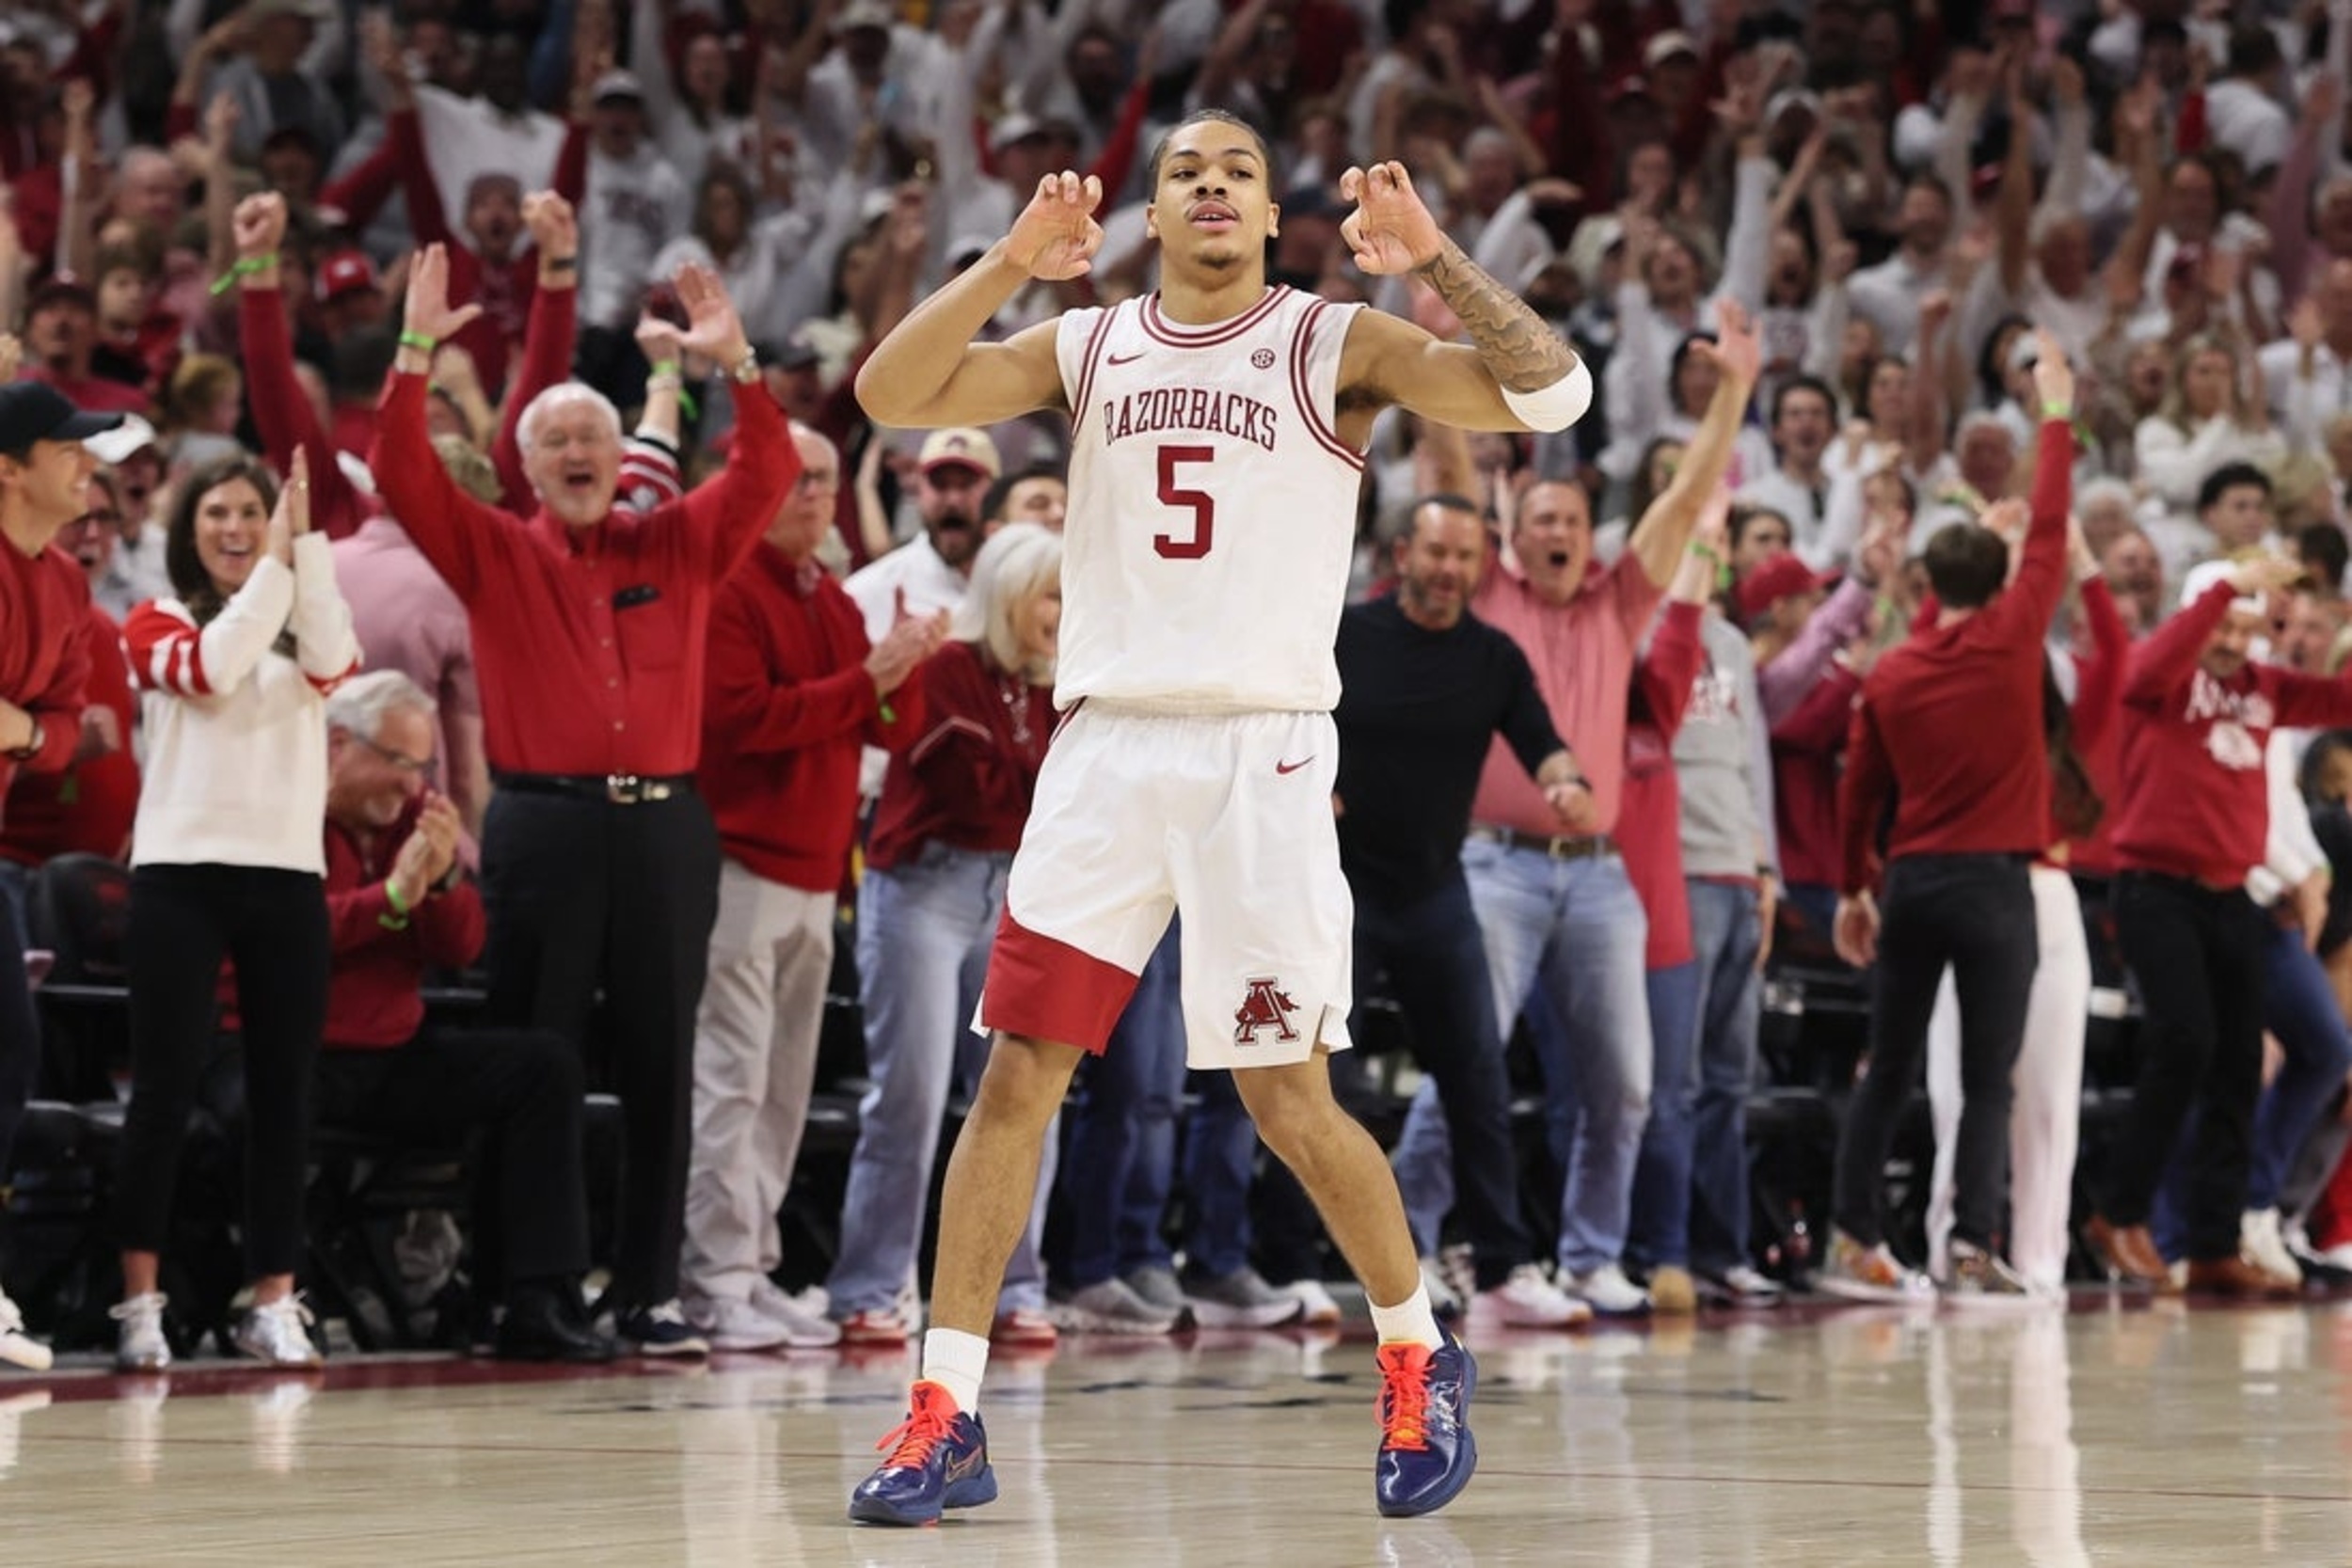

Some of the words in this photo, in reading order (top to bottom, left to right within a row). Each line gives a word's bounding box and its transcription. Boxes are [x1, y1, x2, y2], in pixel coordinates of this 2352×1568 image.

[1104, 388, 1277, 451] RAZORBACKS
[1153, 445, 1215, 560] 5
[1235, 976, 1300, 1047] A
